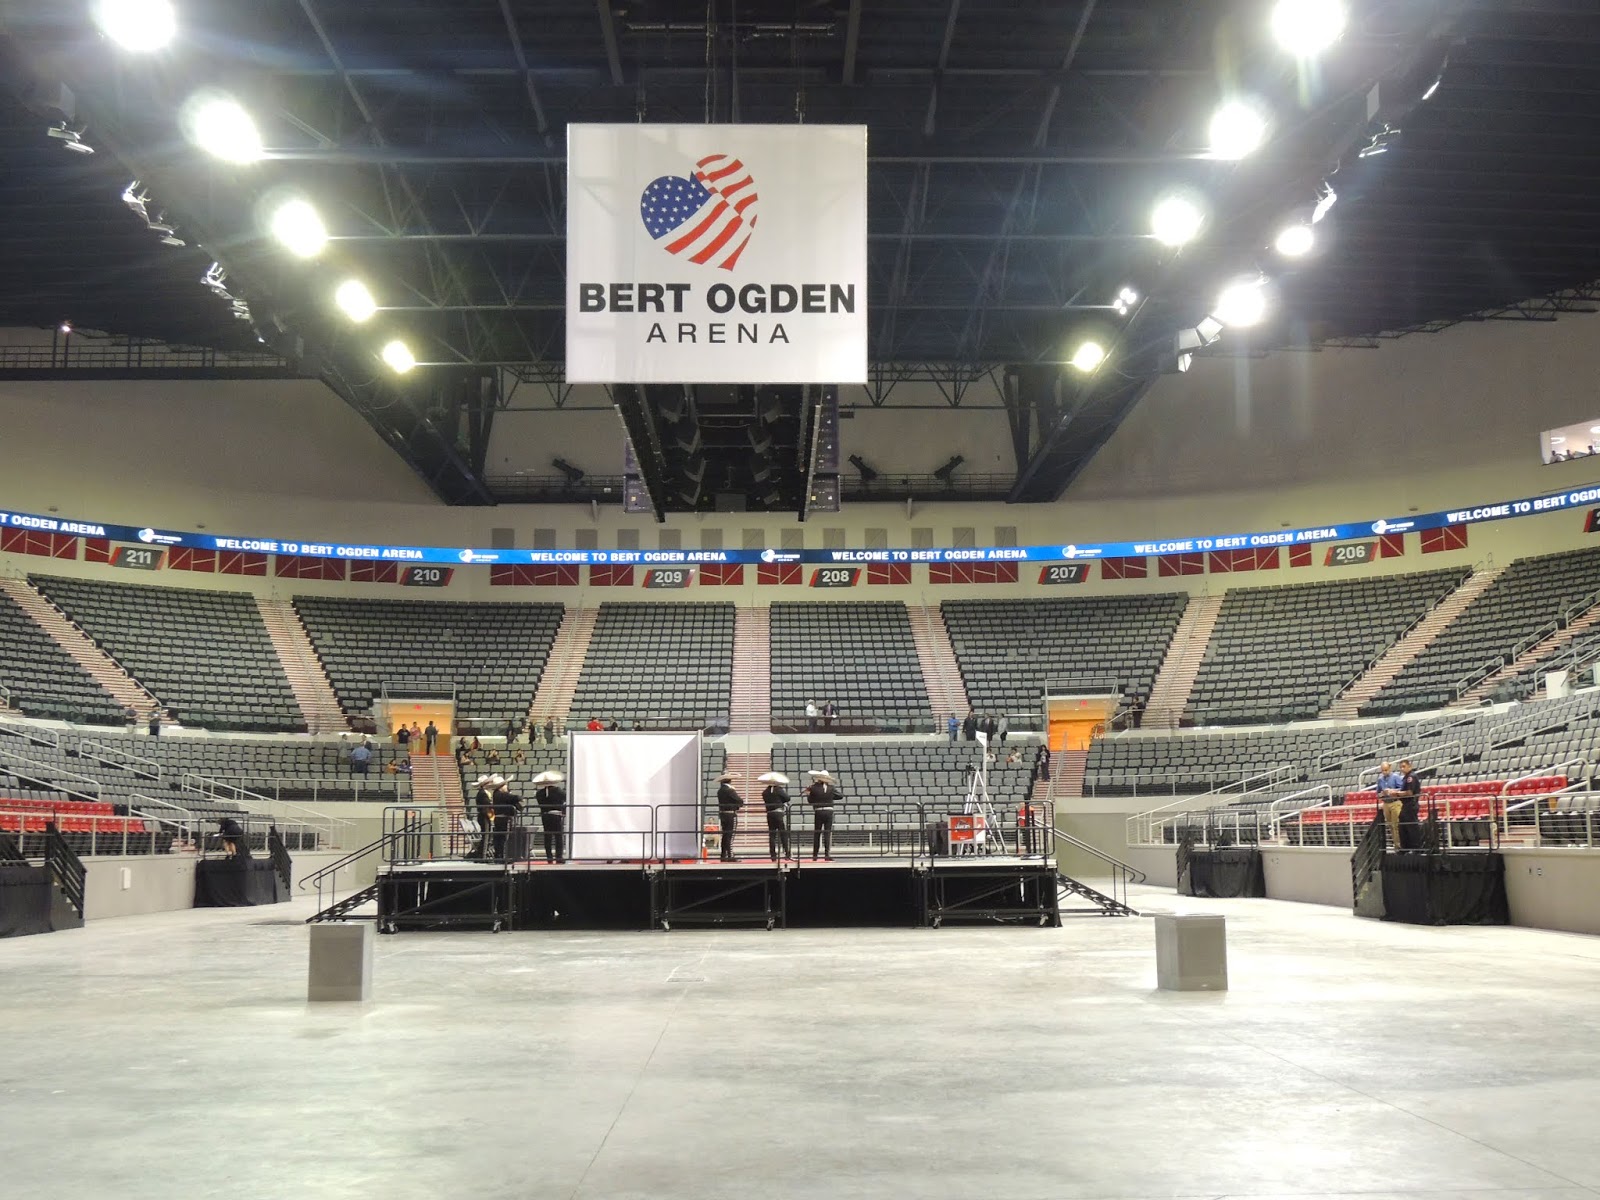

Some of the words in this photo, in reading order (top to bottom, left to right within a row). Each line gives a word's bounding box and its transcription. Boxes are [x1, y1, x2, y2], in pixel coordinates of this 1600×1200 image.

[579, 283, 691, 313] BERT
[706, 283, 855, 314] OGDEN
[646, 323, 790, 344] ARENA
[1447, 505, 1510, 522] WELCOME
[1512, 501, 1531, 513] TO
[1533, 495, 1567, 510] BERT
[12, 515, 57, 530] OGDEN
[60, 523, 105, 536] ARENA
[1134, 541, 1193, 553] WELCOME
[1196, 539, 1212, 549] TO
[1215, 537, 1247, 547] BERT
[1250, 533, 1293, 545] OGDEN
[1296, 528, 1337, 541] ARENA
[215, 539, 278, 551] WELCOME
[281, 543, 298, 552] TO
[301, 544, 333, 554] BERT
[336, 547, 379, 557] OGDEN
[382, 549, 423, 558] ARENA
[832, 551, 889, 560] WELCOME
[892, 551, 908, 560] TO
[911, 551, 941, 560] BERT
[944, 550, 985, 559] OGDEN
[988, 549, 1027, 559] ARENA
[1336, 546, 1365, 560] 206
[126, 550, 152, 564] 211
[531, 552, 588, 561] WELCOME
[591, 552, 607, 561] TO
[610, 552, 641, 561] BERT
[644, 552, 684, 561] OGDEN
[687, 552, 727, 561] ARENA
[413, 568, 440, 582] 210
[655, 571, 682, 583] 209
[822, 570, 850, 583] 208
[1050, 567, 1077, 579] 207
